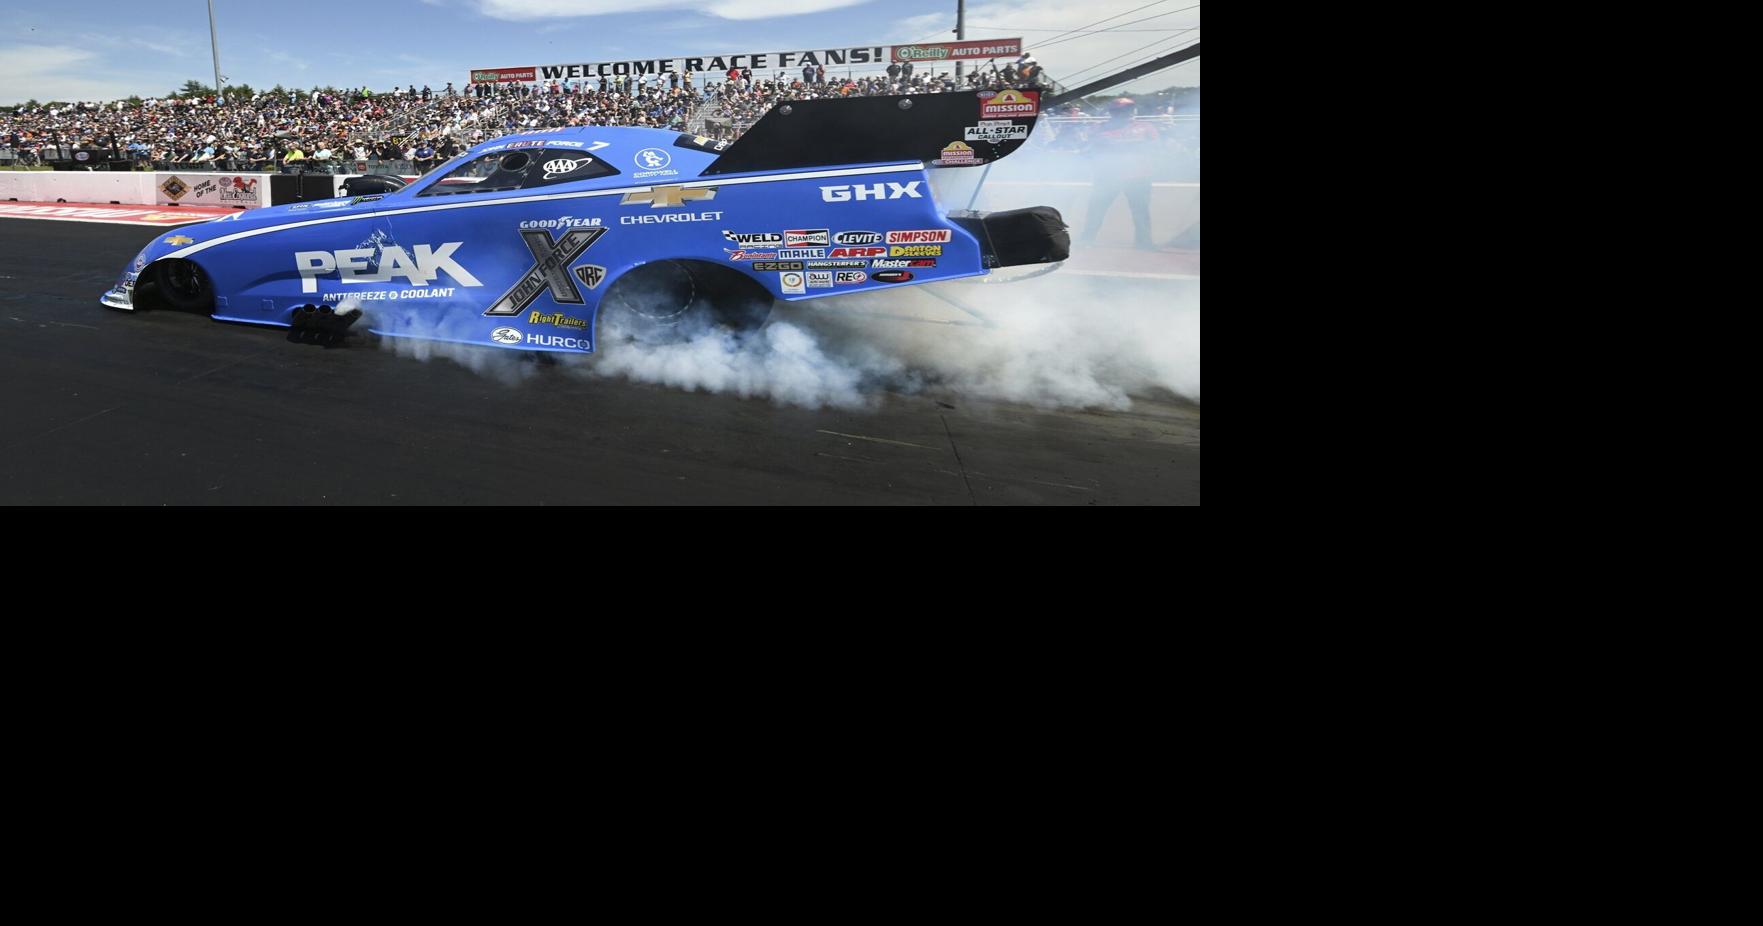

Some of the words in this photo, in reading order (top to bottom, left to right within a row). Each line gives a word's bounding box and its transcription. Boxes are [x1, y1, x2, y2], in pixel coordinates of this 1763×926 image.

[896, 46, 950, 60] O'Reilly
[952, 47, 979, 56] AUTO
[982, 44, 1017, 54] PARTS
[541, 59, 674, 79] WELCOME
[685, 54, 766, 72] RACE
[779, 47, 882, 67] FANS!
[587, 141, 610, 151] 7
[544, 159, 577, 174] AAA
[194, 180, 211, 191] HOME
[196, 190, 204, 198] OF
[205, 185, 216, 194] THE
[819, 181, 925, 202] GHX
[620, 211, 724, 225] CHEVROLET
[737, 233, 783, 243] WELD
[787, 234, 827, 242] CHAMPION
[834, 233, 882, 244] CLEVITE
[889, 231, 947, 243] SIMPSON
[780, 249, 824, 258] MAHLE
[830, 248, 886, 258] ARP
[295, 241, 484, 293] PEAK
[509, 272, 542, 309] JOHN
[539, 233, 581, 277] FORCE
[400, 287, 456, 299] COOLANT
[527, 334, 590, 349] HURCO
